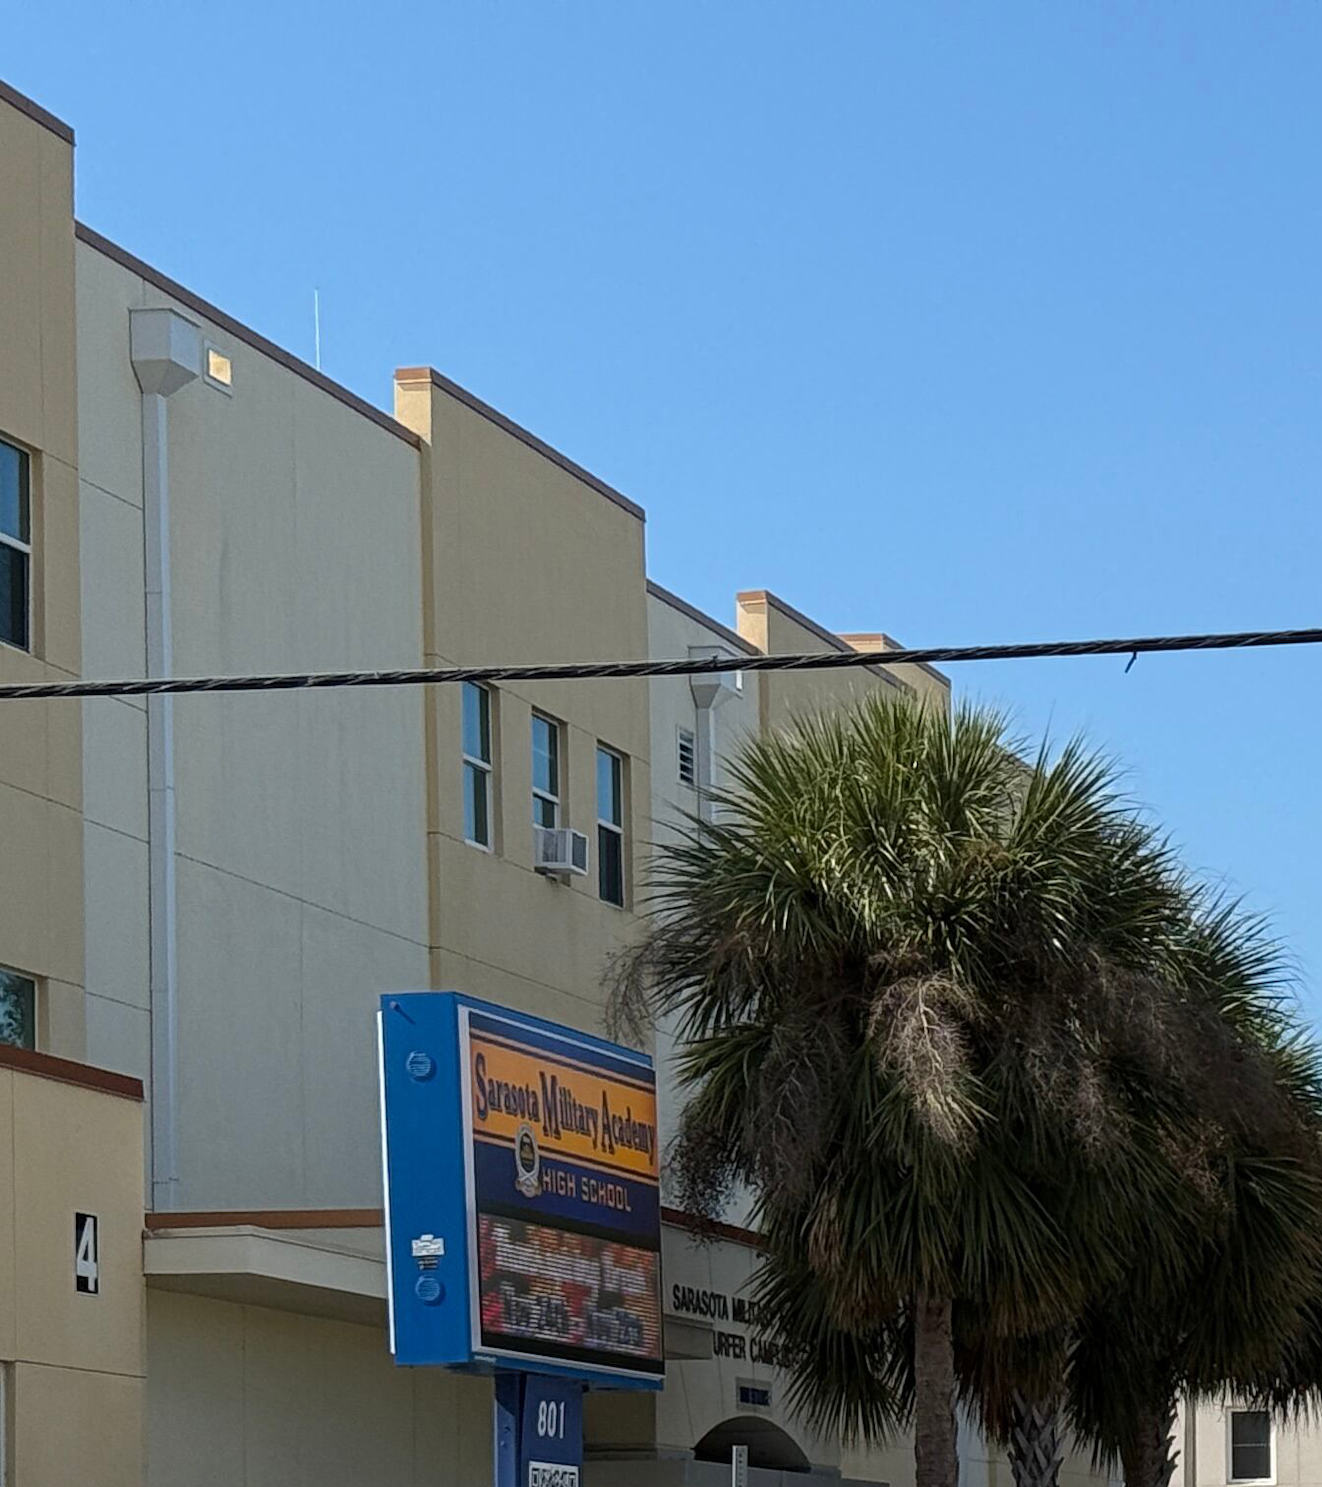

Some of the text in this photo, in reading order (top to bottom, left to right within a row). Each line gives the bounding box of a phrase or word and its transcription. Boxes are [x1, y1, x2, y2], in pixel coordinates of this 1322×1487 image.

[475, 1051, 657, 1167] Sarasota Military Academy
[541, 1166, 632, 1213] HIGH SCHOOL
[76, 1216, 98, 1292] 4
[672, 1283, 729, 1322] SARASOTA
[712, 1330, 747, 1361] URFER
[537, 1400, 566, 1440] 801
